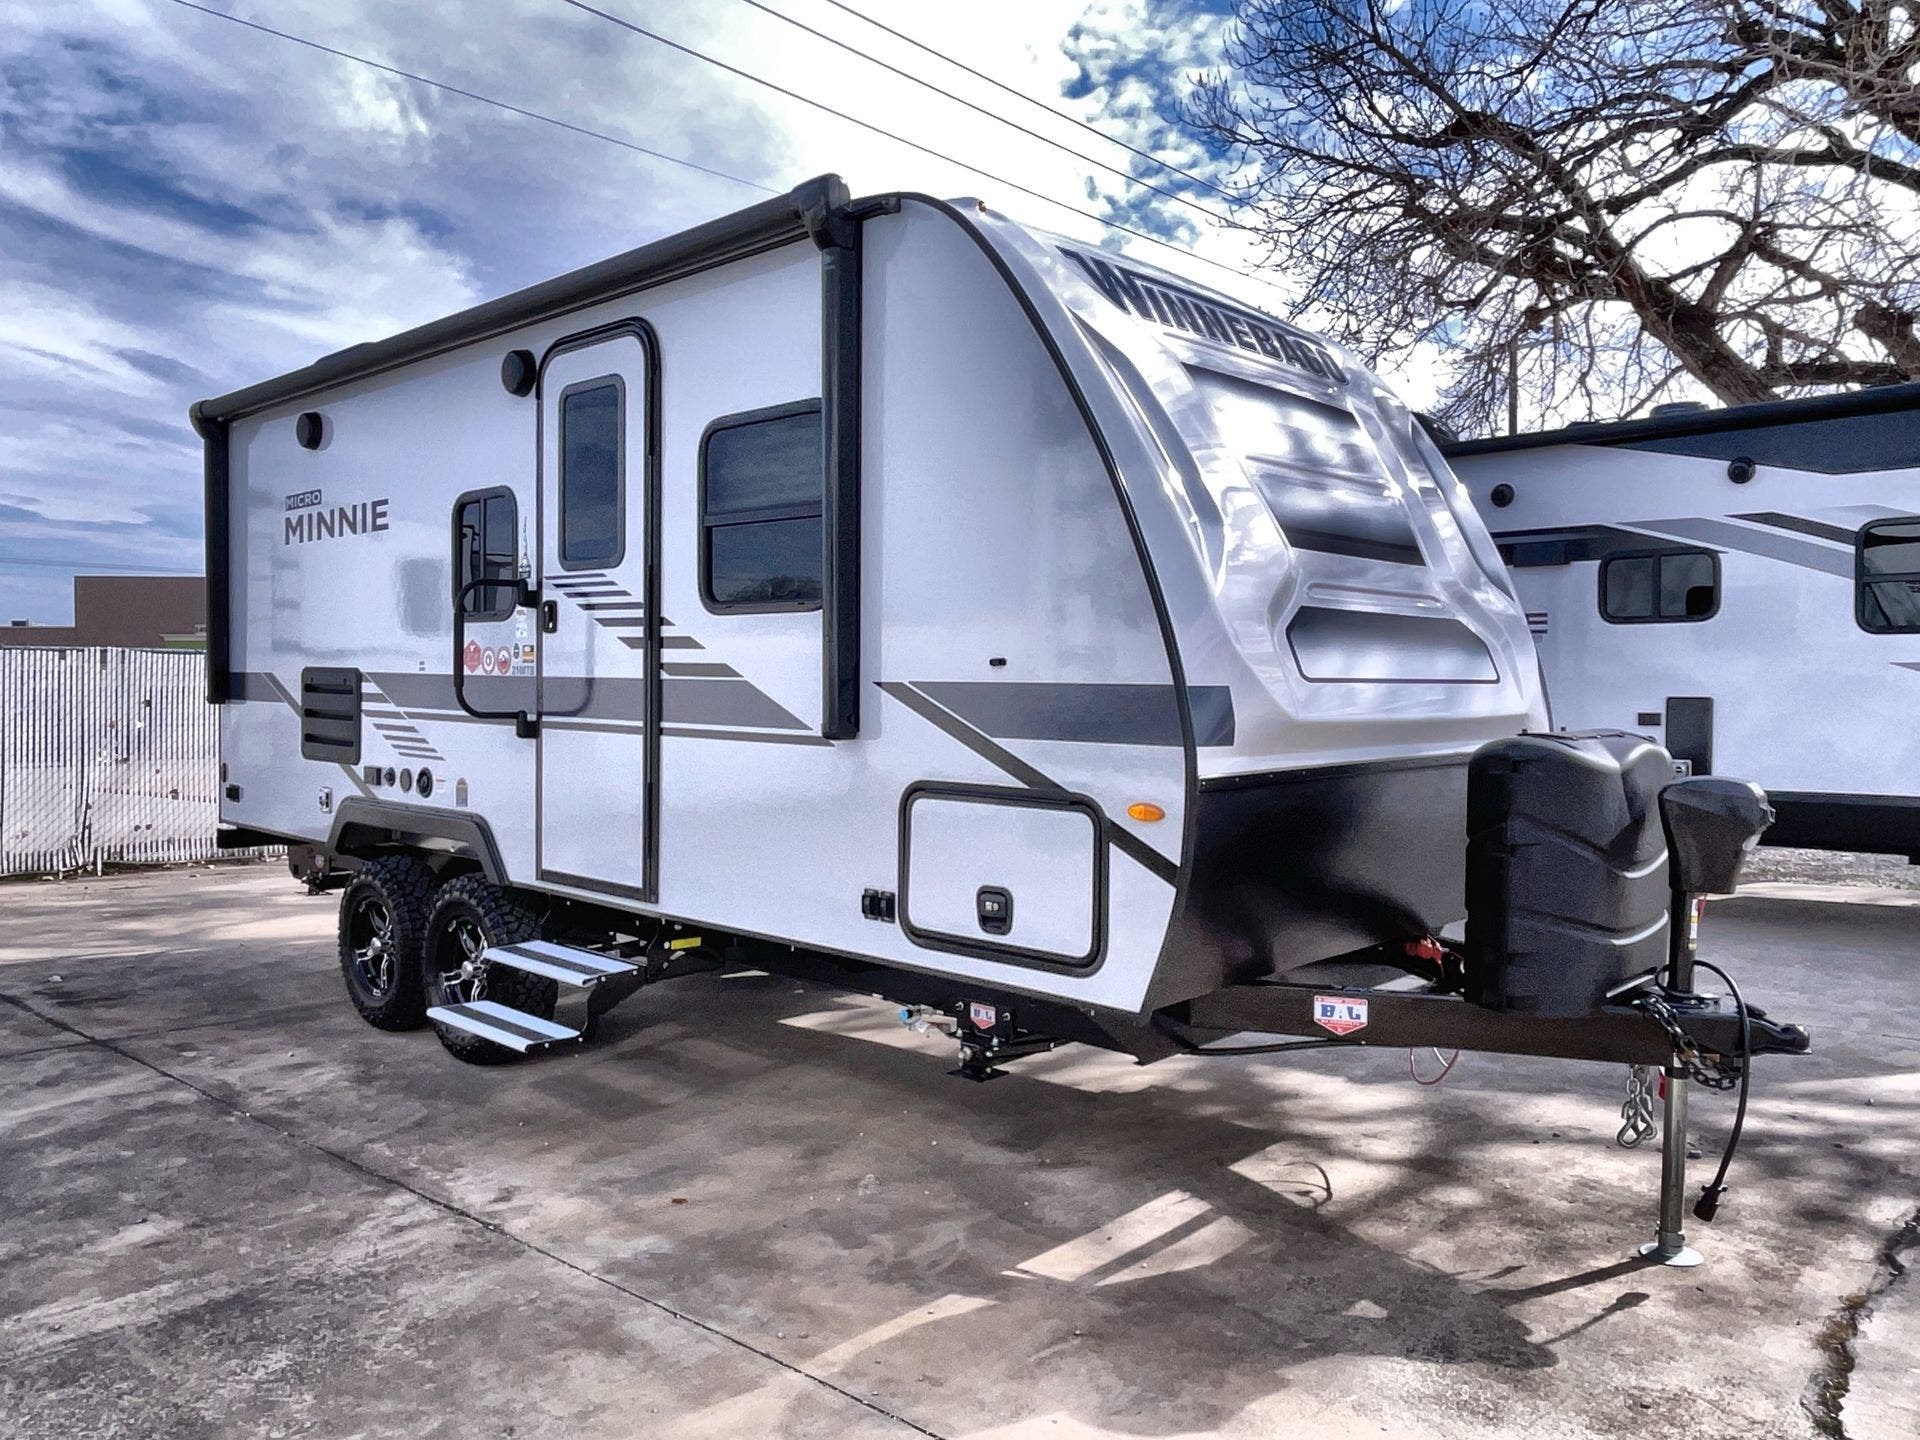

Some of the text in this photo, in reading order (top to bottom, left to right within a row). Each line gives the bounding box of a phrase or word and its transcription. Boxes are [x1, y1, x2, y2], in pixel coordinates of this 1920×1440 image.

[1056, 245, 1350, 385] WINNEBAGO
[285, 498, 389, 545] MINNIE
[286, 491, 321, 510] MICRO
